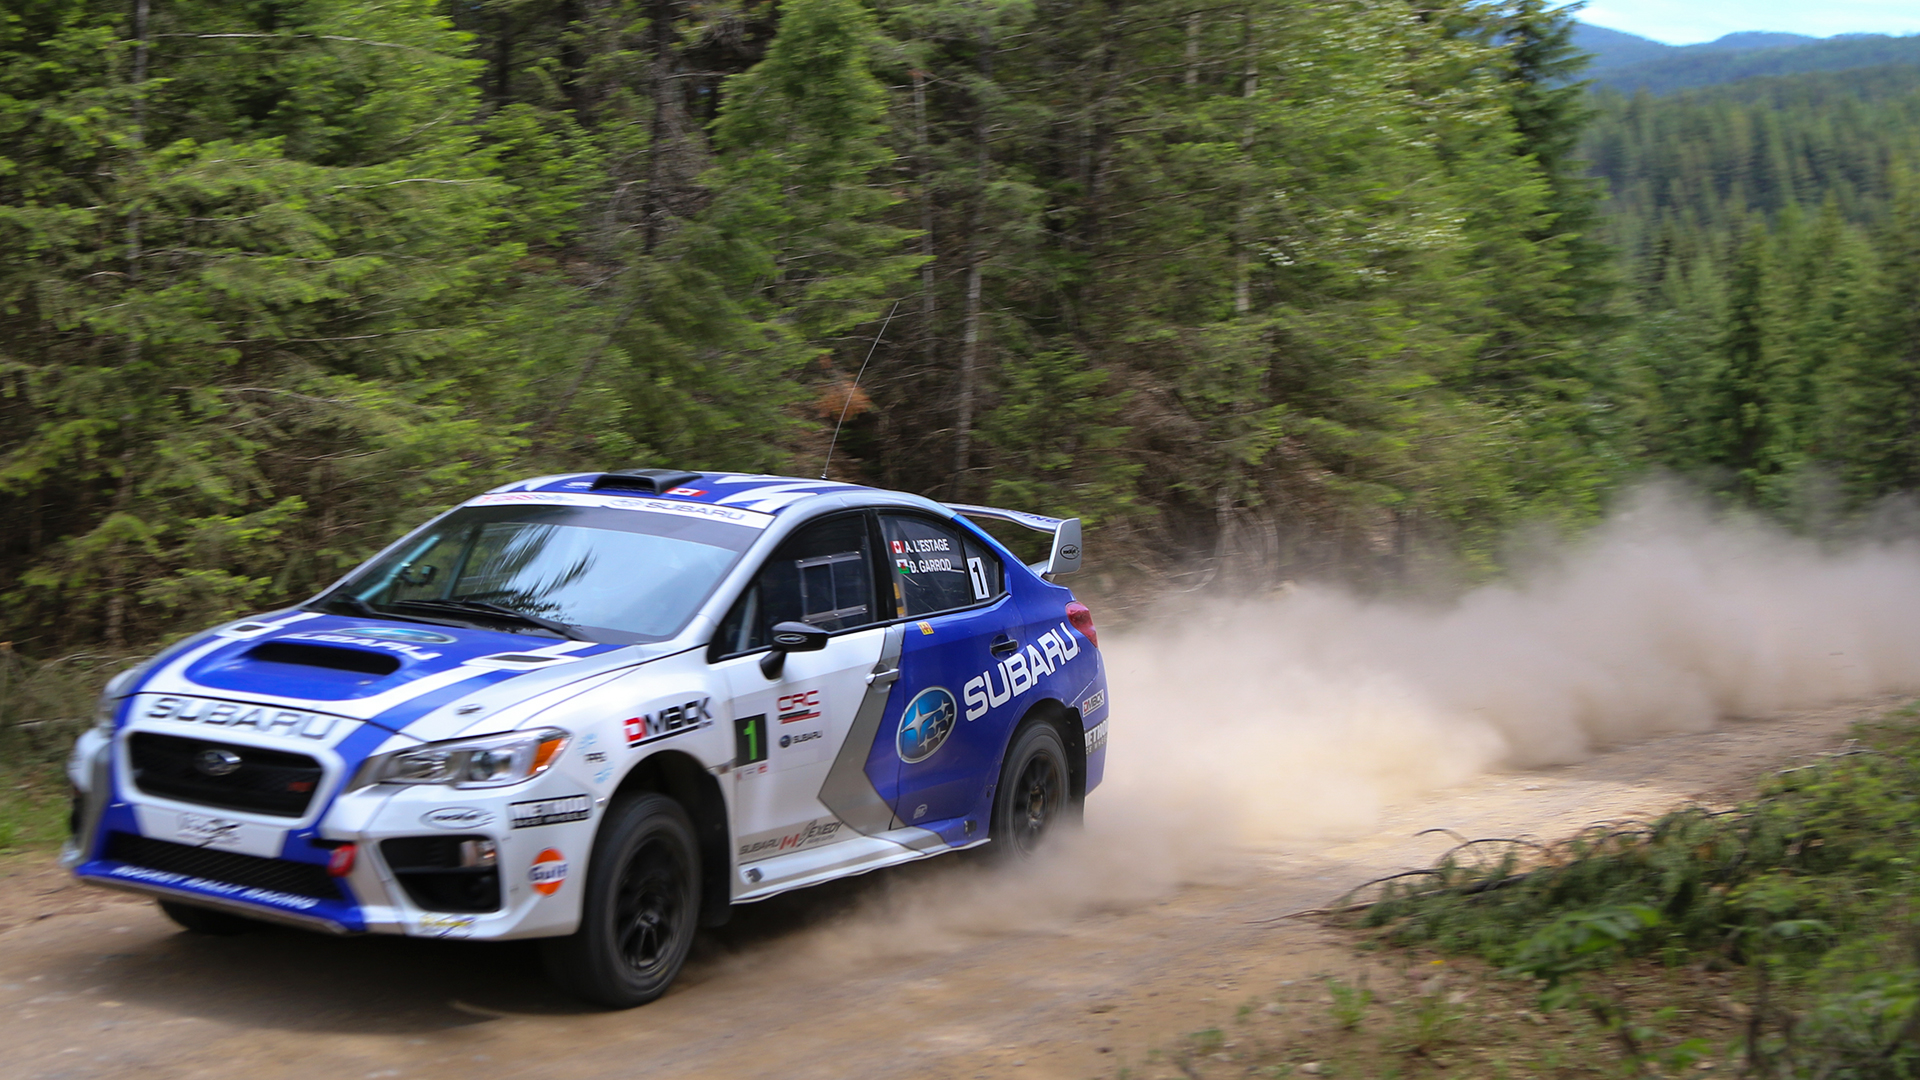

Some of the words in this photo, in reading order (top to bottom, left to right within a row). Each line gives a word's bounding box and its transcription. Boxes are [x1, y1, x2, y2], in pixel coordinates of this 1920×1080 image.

[646, 501, 746, 520] SUBARU
[905, 541, 914, 553] A.
[914, 539, 950, 553] L'ESTAGE
[909, 560, 919, 573] D.
[919, 558, 952, 572] GARROD
[972, 561, 985, 595] 1
[963, 622, 1080, 722] SUBARU
[776, 690, 820, 711] CRC
[146, 697, 339, 740] SUBARU
[622, 696, 713, 742] DMACK
[743, 720, 758, 760] 1
[792, 730, 823, 744] SUBARU
[807, 820, 844, 837] EXEDY
[738, 839, 779, 855] SUBARU
[528, 863, 569, 882] Gulf
